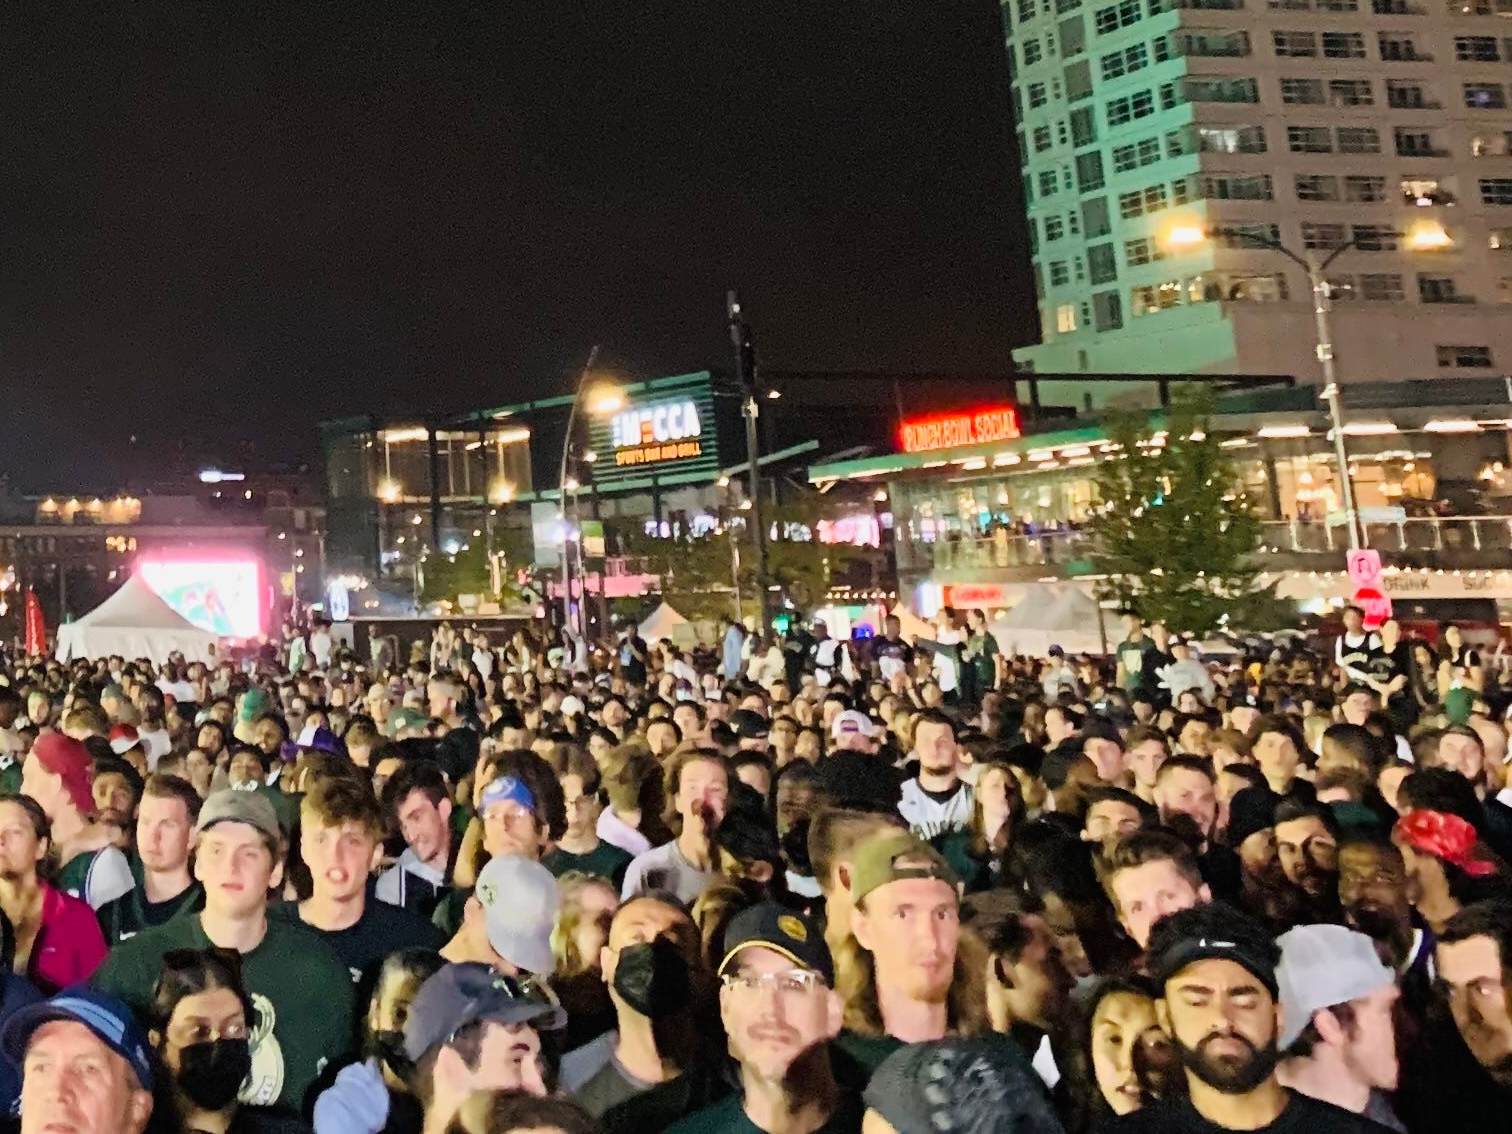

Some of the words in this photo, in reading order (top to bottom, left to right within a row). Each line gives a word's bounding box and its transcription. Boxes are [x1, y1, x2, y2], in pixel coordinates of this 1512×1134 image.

[622, 401, 701, 446] MECCA
[904, 423, 942, 452] PUNCH
[943, 417, 976, 447] BOWL
[975, 410, 1020, 443] SOCIAL
